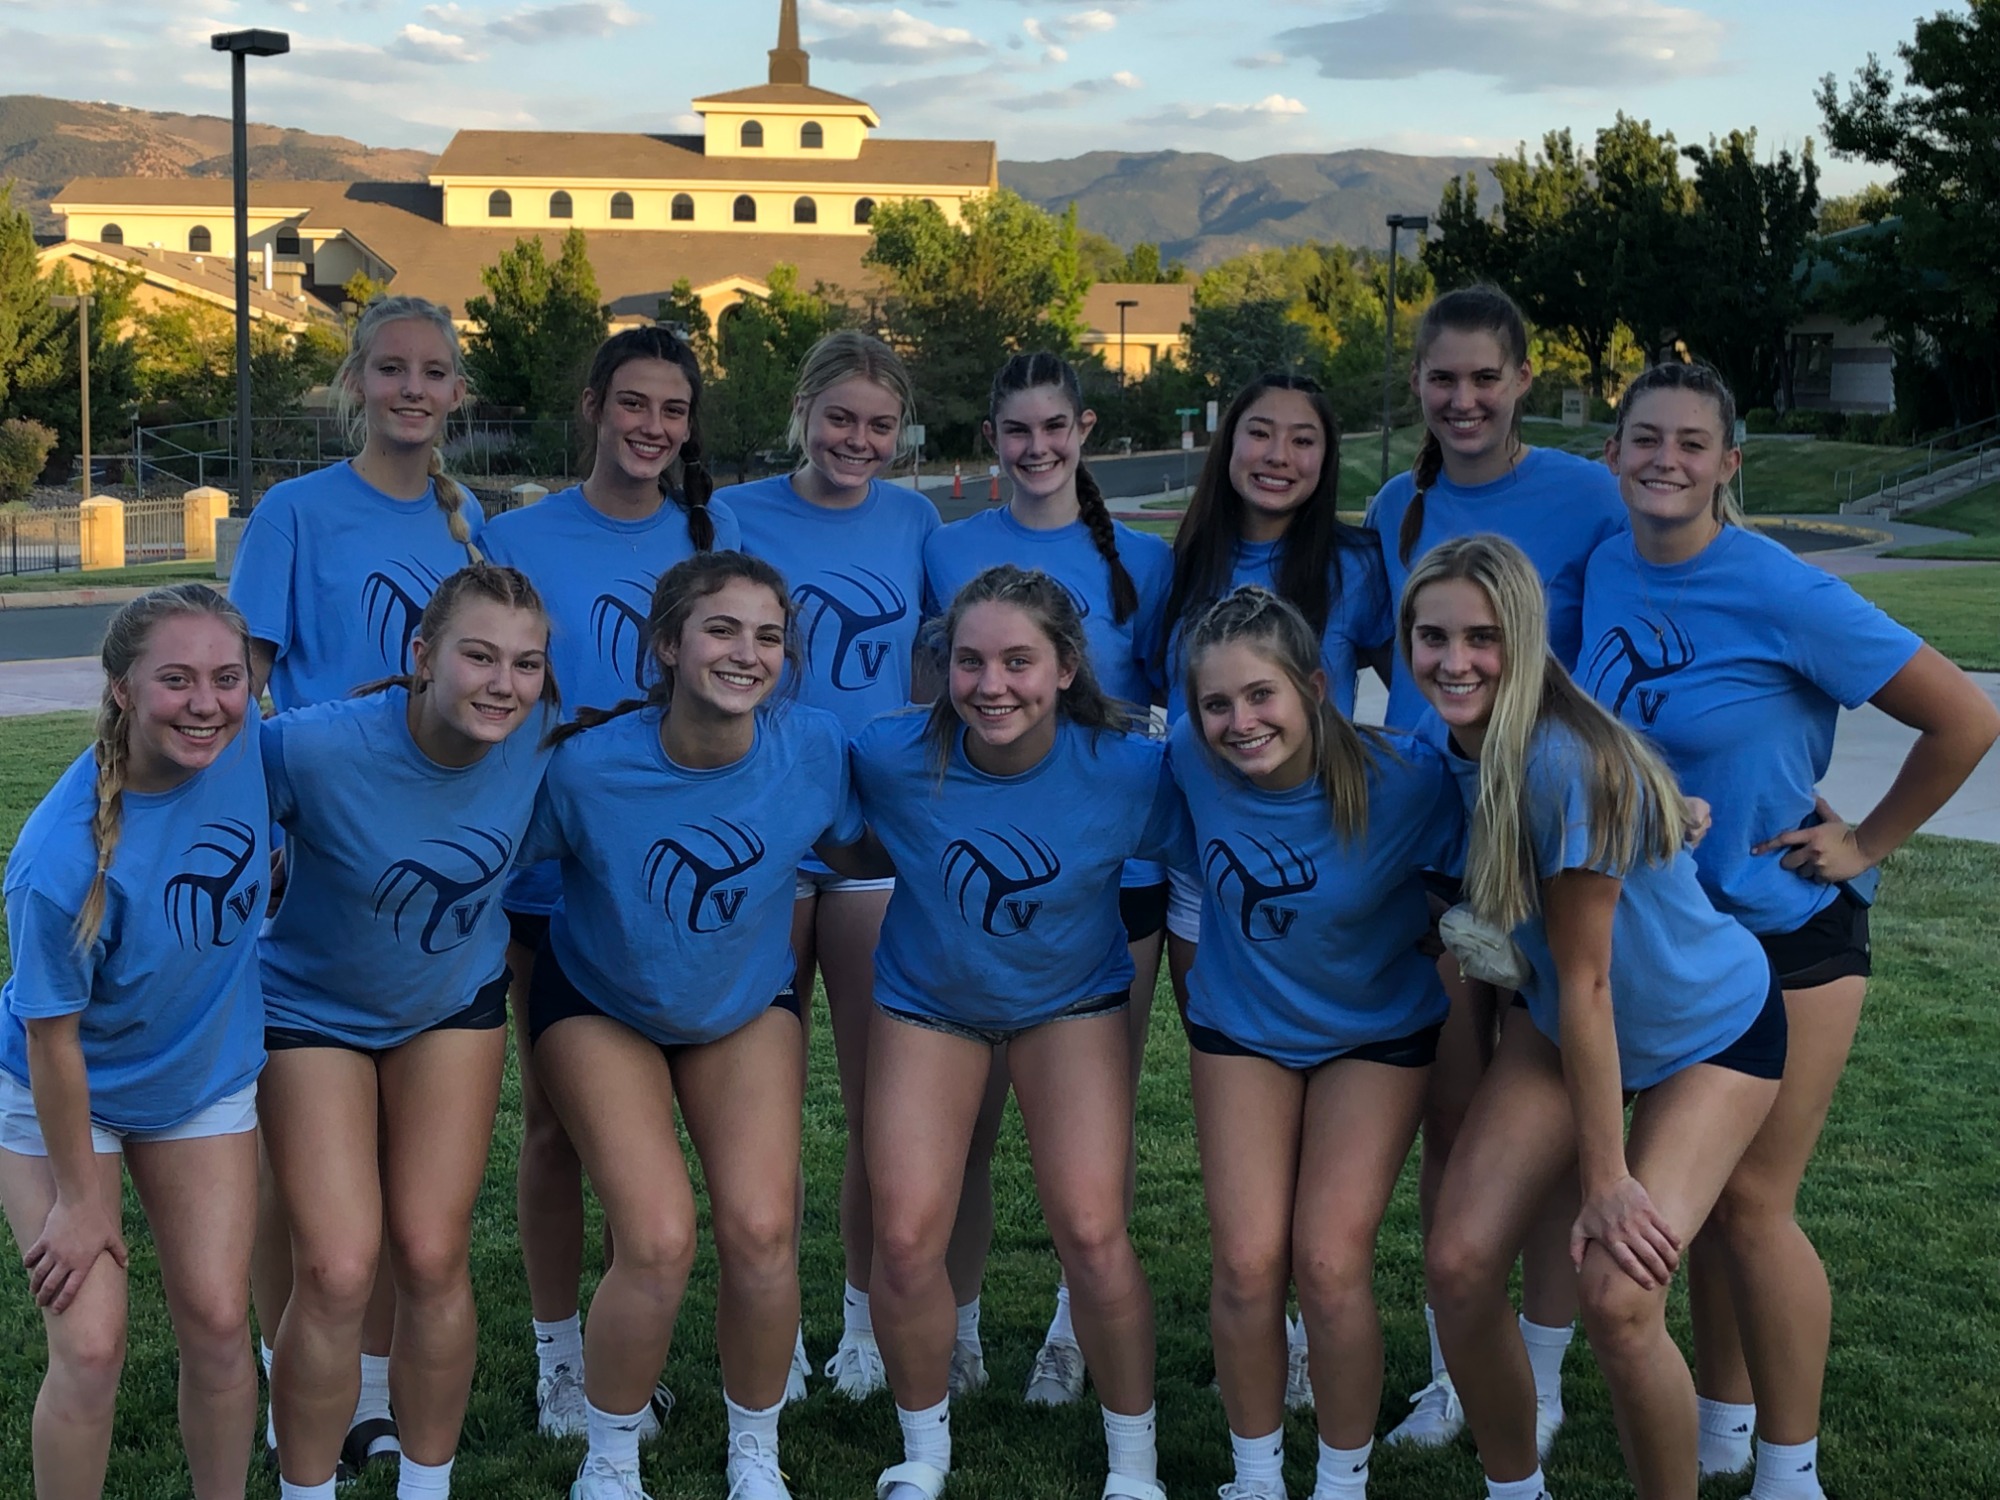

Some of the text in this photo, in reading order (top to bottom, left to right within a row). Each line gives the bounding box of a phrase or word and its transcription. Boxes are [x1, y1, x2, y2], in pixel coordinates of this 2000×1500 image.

[856, 641, 891, 680] V
[1637, 688, 1668, 726] V
[227, 880, 260, 925] V
[453, 895, 490, 938] V
[711, 887, 748, 923] V
[1004, 900, 1042, 932] V
[1260, 904, 1298, 936] V
